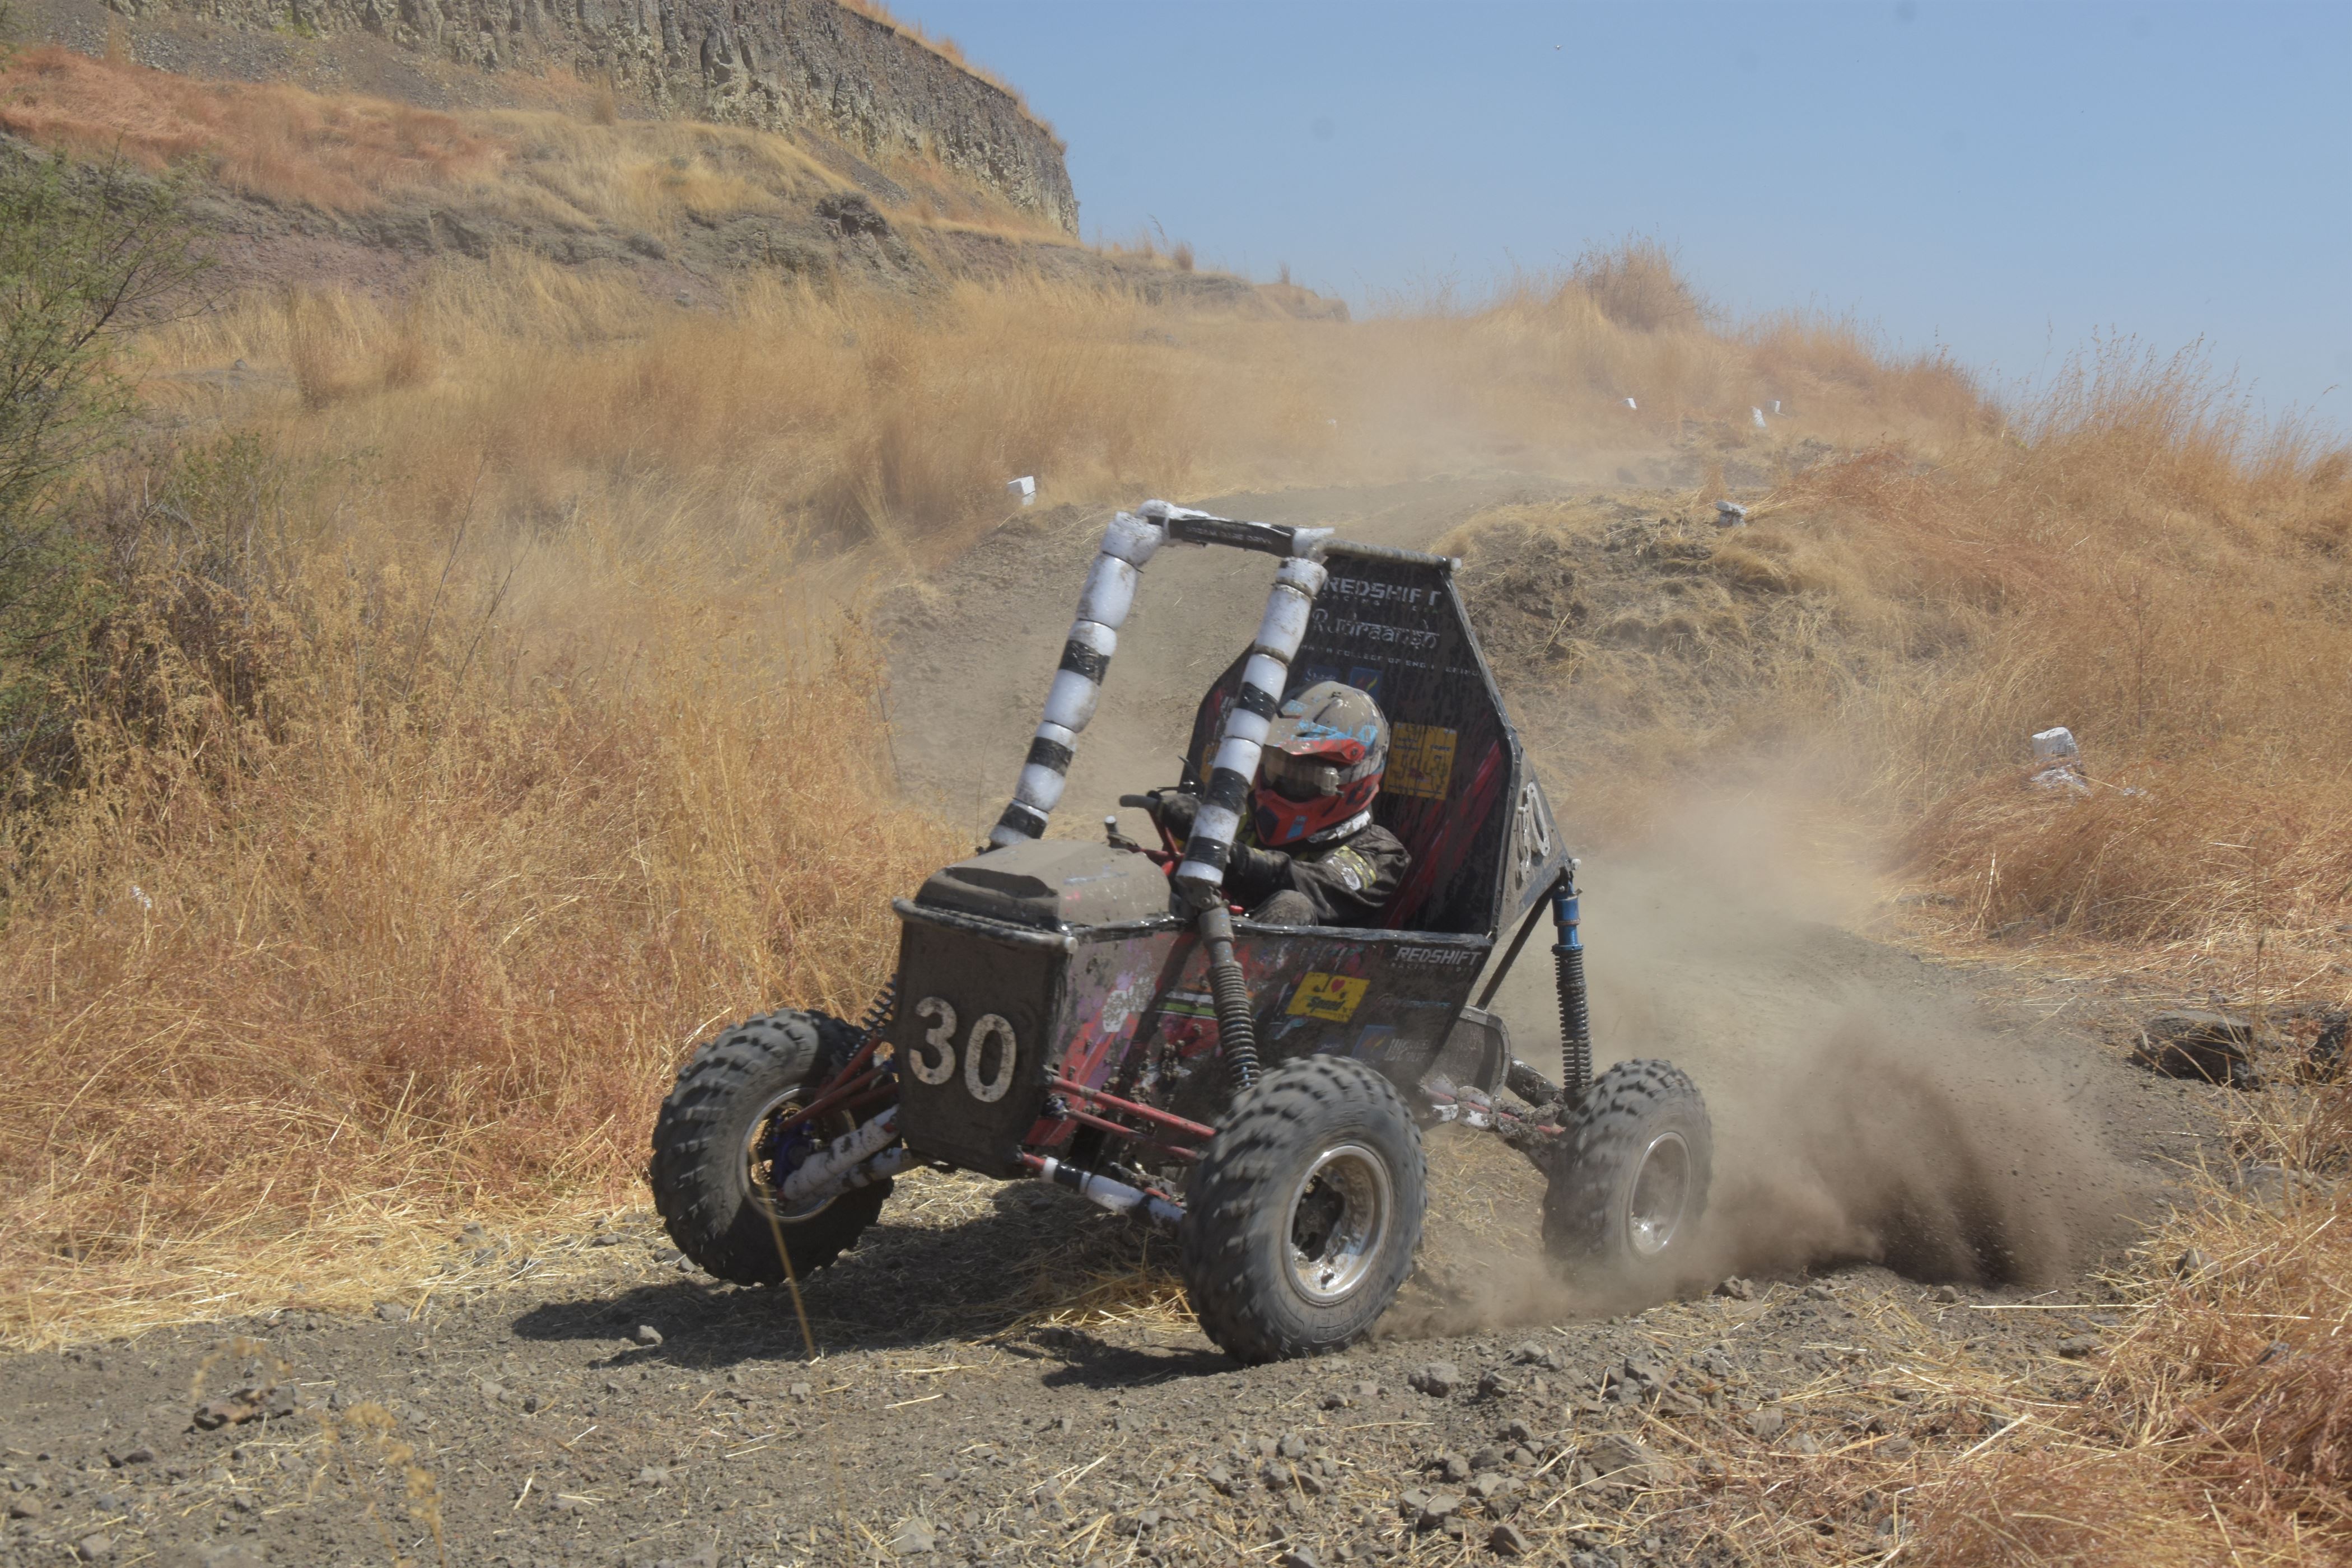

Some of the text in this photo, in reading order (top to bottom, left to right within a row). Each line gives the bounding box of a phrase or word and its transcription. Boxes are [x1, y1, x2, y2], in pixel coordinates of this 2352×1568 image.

[1322, 577, 1442, 606] REDSHIFT
[1395, 946, 1483, 966] REDSHIFT
[909, 996, 1017, 1103] 30
